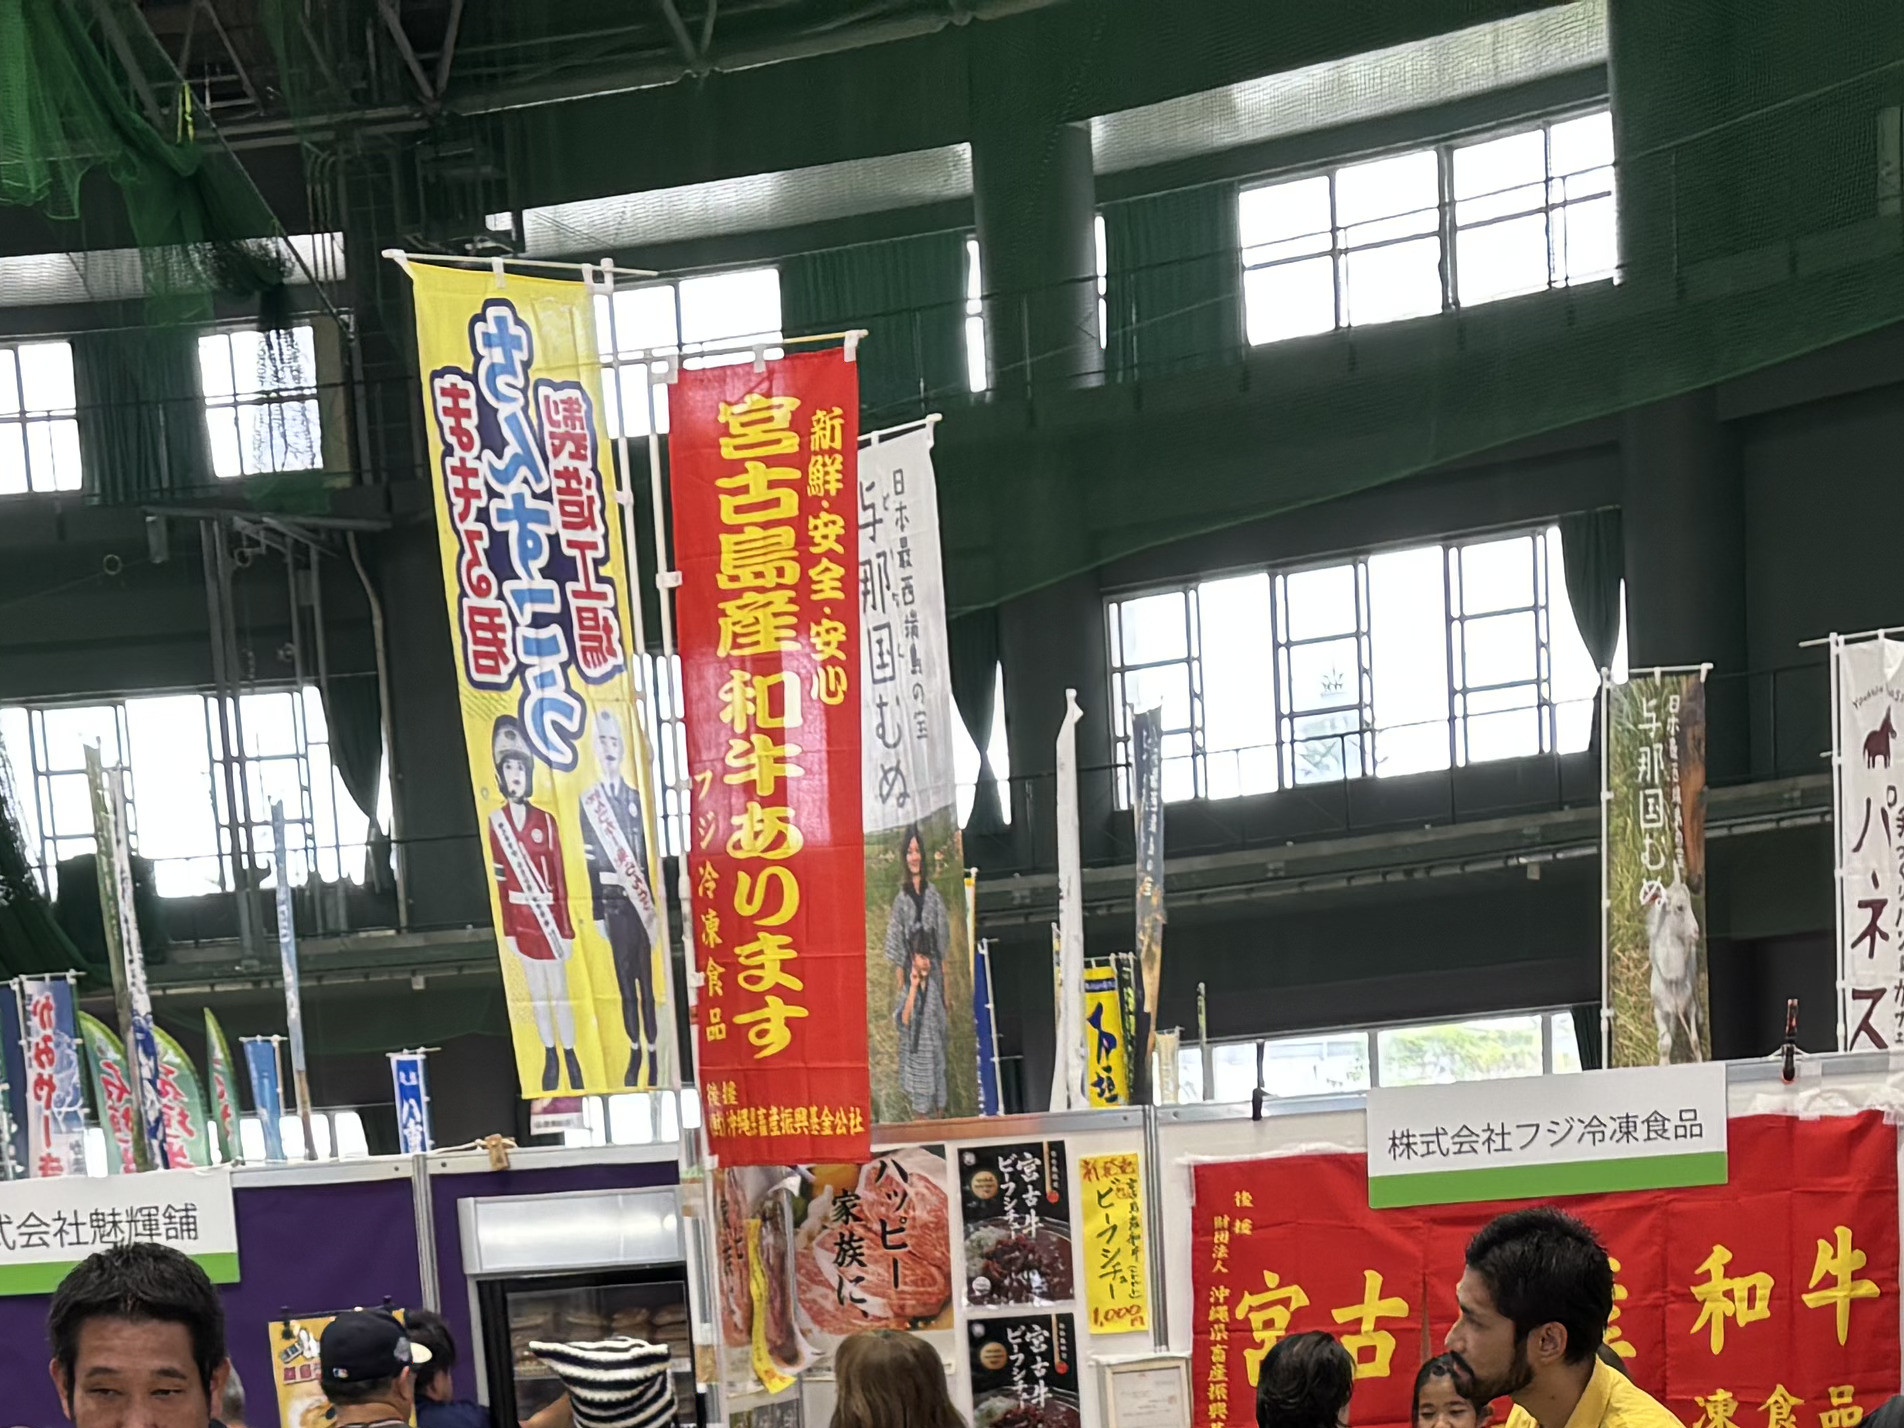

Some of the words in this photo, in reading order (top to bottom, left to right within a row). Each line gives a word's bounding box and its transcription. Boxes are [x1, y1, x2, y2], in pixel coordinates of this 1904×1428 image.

[694, 770, 727, 1041] フジ冷凍食品
[1386, 1107, 1705, 1161] 株式会社フジ冷凍食品
[877, 1158, 910, 1290] ハッピー
[1017, 1151, 1045, 1238] 宮古牛
[1024, 1324, 1053, 1409] 宮古牛
